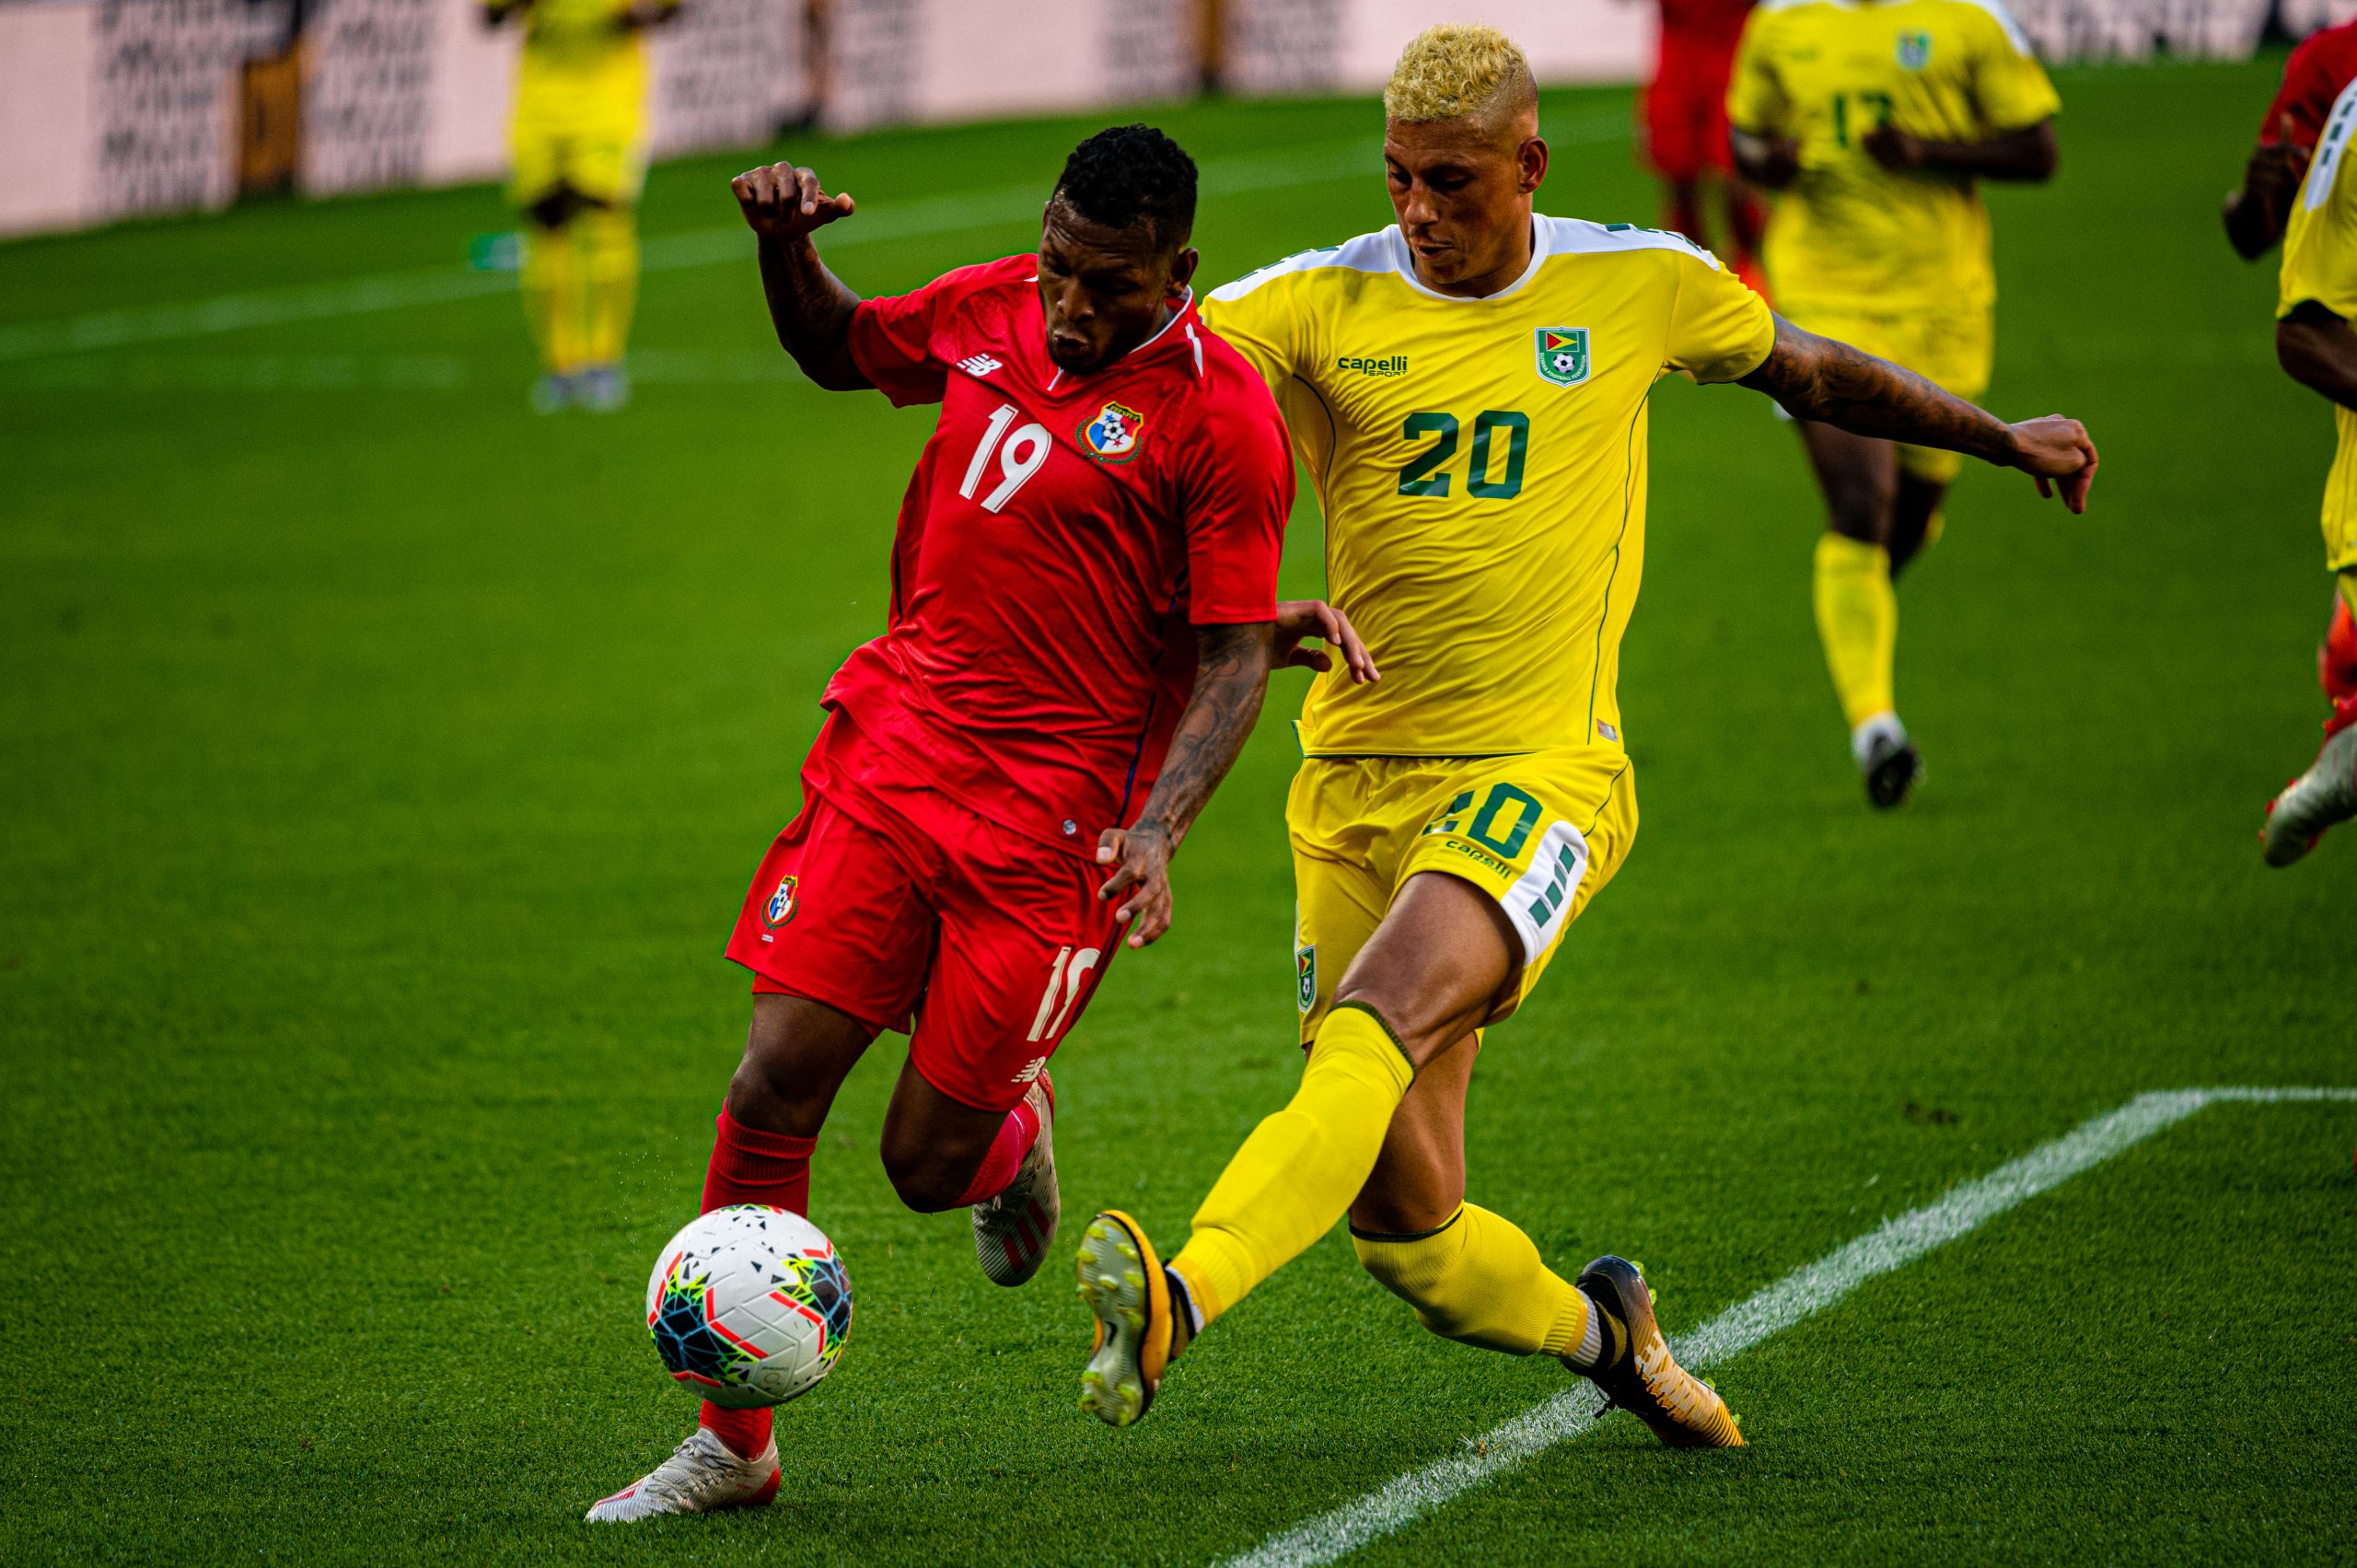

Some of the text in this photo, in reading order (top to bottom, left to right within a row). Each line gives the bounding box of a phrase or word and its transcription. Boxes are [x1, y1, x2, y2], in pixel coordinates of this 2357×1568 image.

[1338, 355, 1408, 375] capelli
[1547, 369, 1573, 381] FOOTBALL
[958, 402, 1052, 514] 19
[1397, 409, 1530, 500] 20
